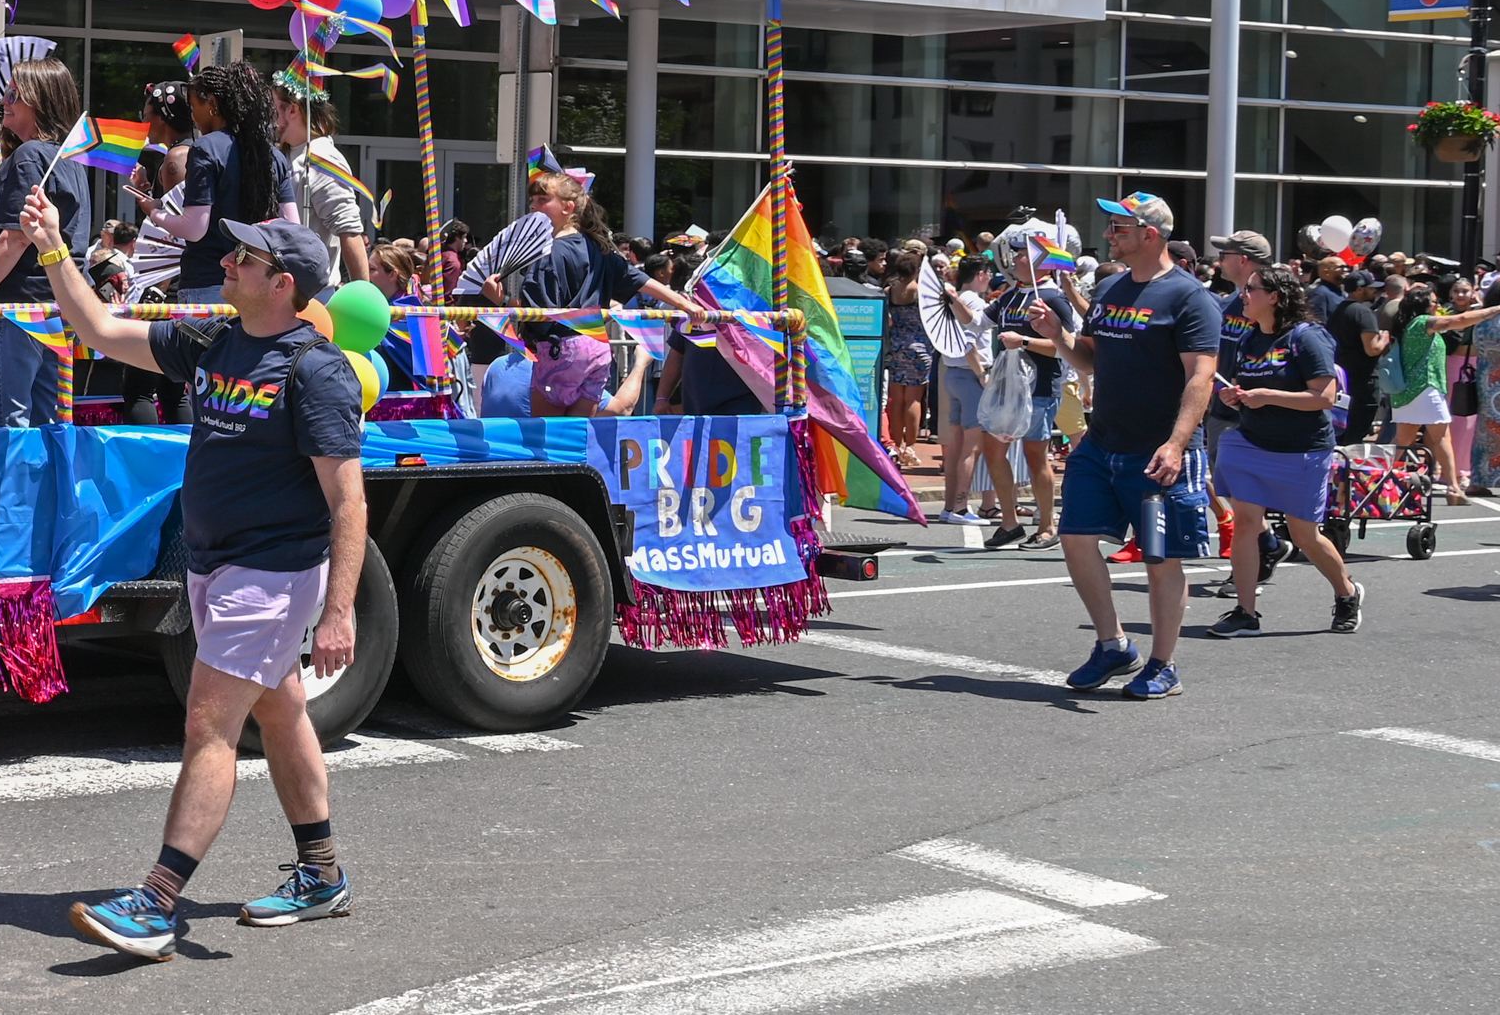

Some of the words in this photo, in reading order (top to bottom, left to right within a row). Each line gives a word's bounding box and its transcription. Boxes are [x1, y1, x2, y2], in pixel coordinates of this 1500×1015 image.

[1087, 303, 1155, 331] PRIDE
[619, 436, 774, 491] PRIDE
[657, 486, 763, 538] BRG
[624, 539, 787, 573] MassMutual
